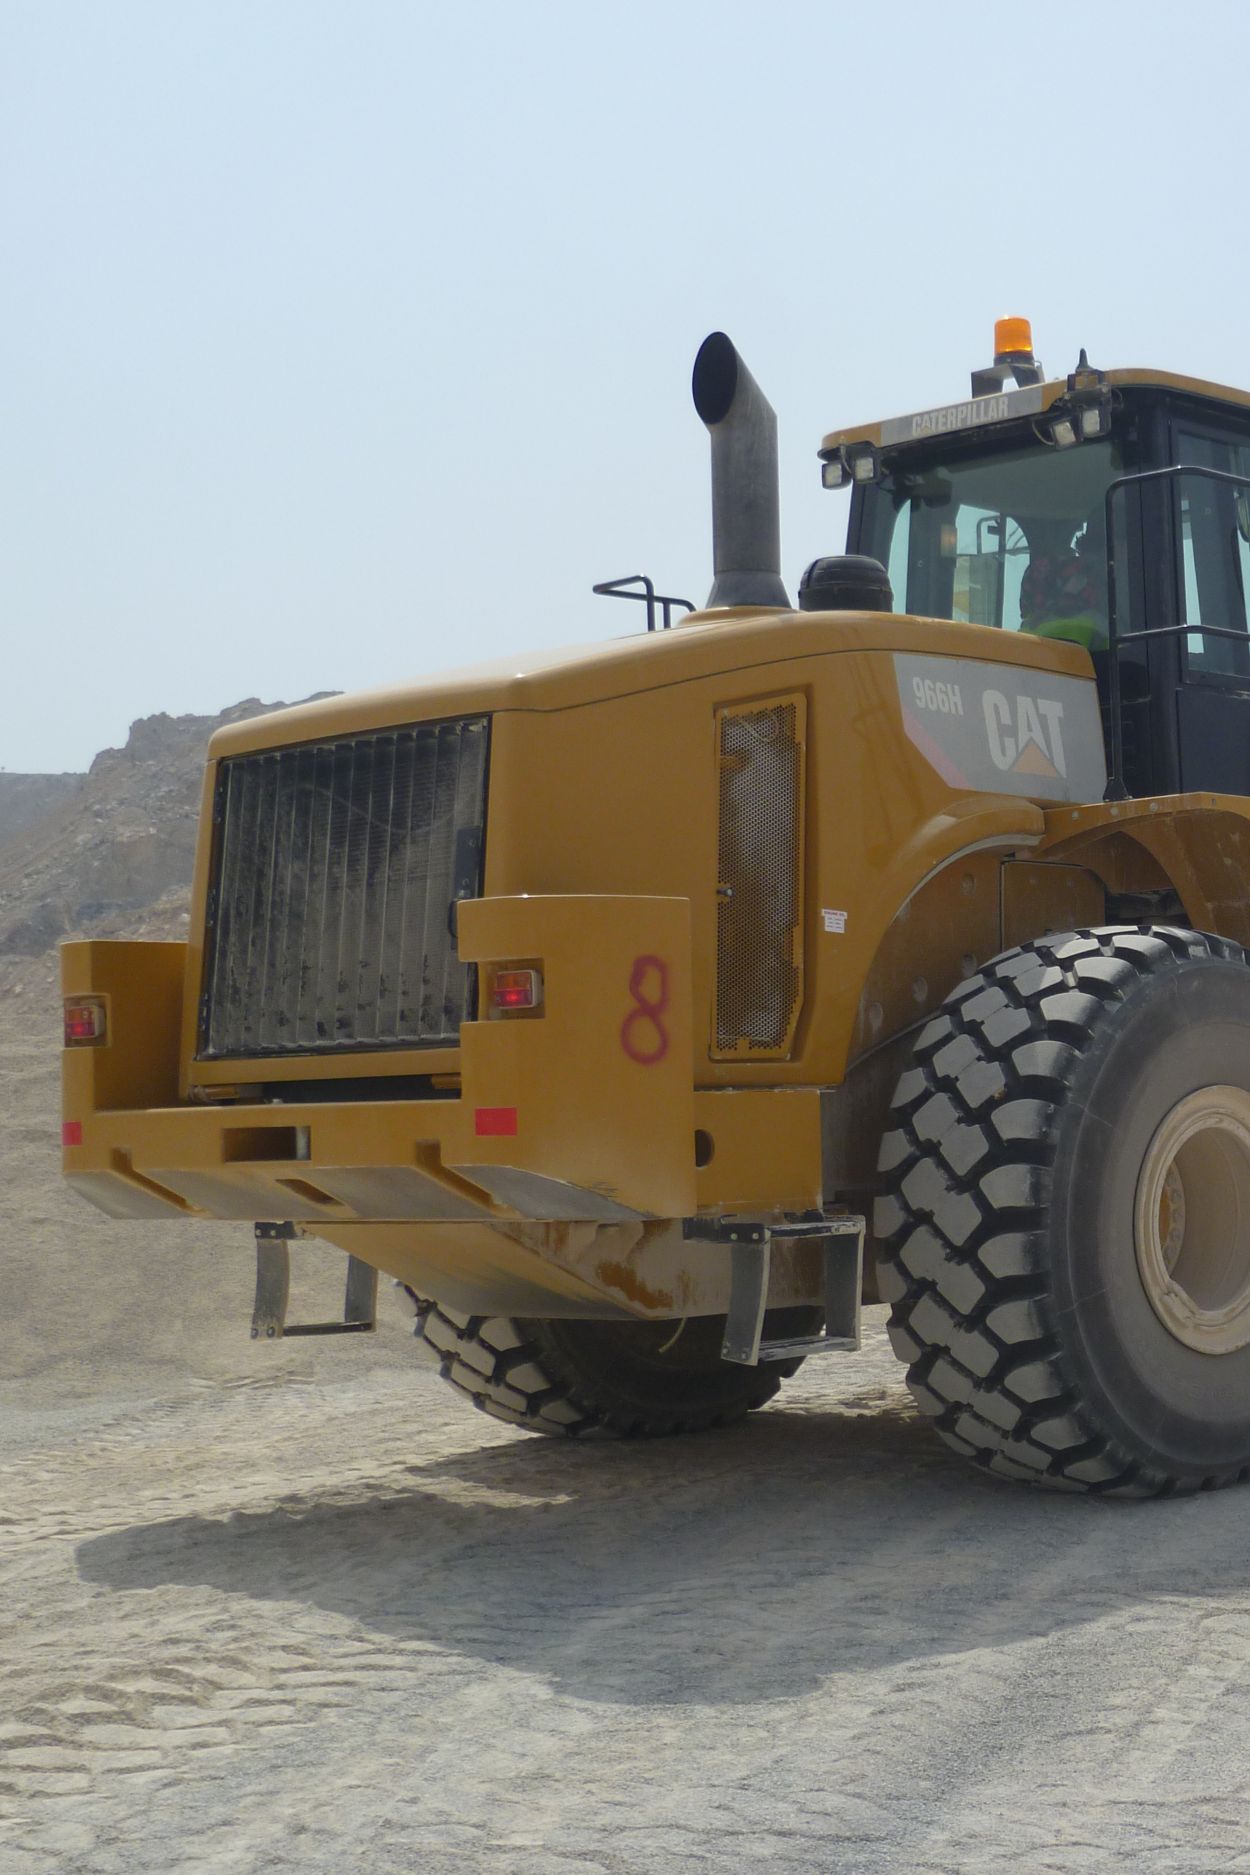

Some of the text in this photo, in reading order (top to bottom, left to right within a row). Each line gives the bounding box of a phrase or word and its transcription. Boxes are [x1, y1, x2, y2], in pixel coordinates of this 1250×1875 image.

[912, 396, 1009, 437] CATERPILLAR
[912, 676, 964, 716] 966H
[982, 689, 1067, 778] CAT
[620, 954, 669, 1066] 8
